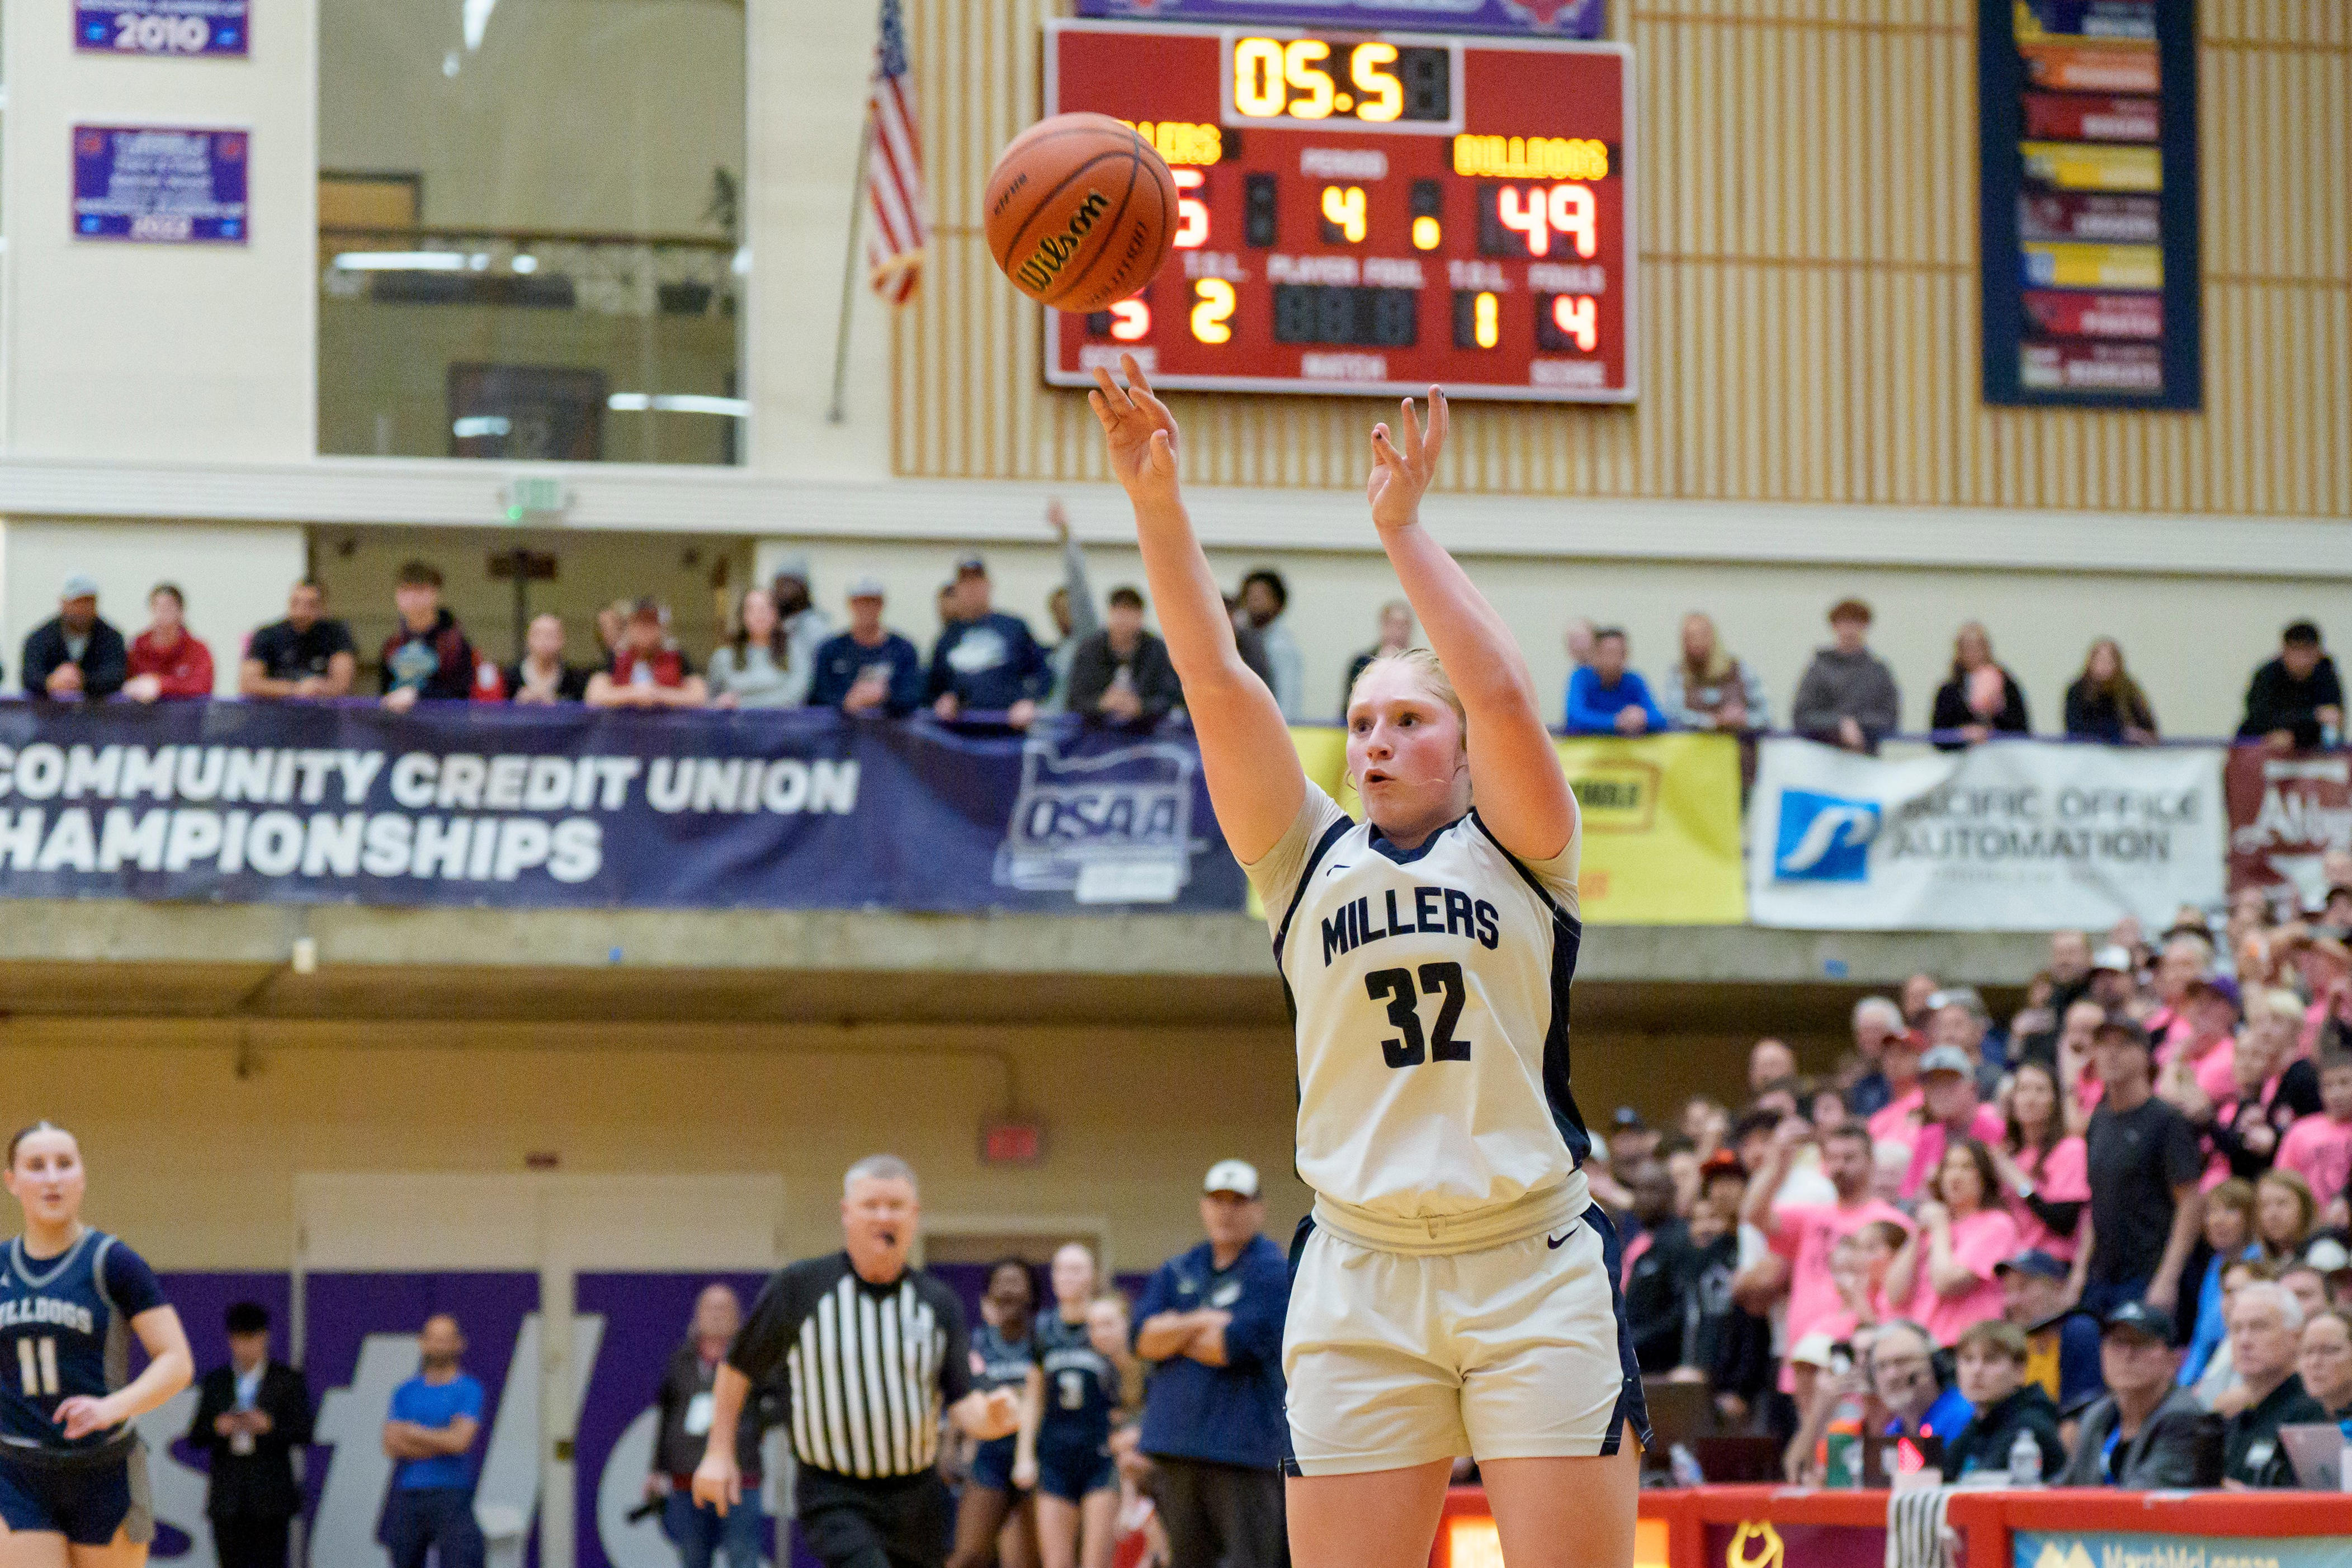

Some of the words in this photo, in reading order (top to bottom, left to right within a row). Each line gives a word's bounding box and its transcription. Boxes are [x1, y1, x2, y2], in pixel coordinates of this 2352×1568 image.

[114, 12, 210, 51] 2010
[1234, 37, 1404, 122] 05.5
[1454, 134, 1608, 181] BULLDOGS
[1017, 188, 1112, 292] Wilson
[1321, 185, 1367, 243] 4
[1496, 182, 1598, 259] 49
[1191, 277, 1236, 344] 2
[1474, 291, 1498, 348] 1
[1552, 294, 1598, 352] 4
[390, 752, 641, 812] CREDIT
[646, 755, 862, 815] UNION
[2055, 786, 2203, 826] OFFICE
[0, 806, 603, 883] HAMPIONSHIPS
[1892, 823, 2172, 864] AUTOMATION
[1321, 886, 1499, 968] MILLERS
[1364, 961, 1471, 1069] 32
[0, 1295, 94, 1336] LLDOGS
[18, 1335, 58, 1396] 11
